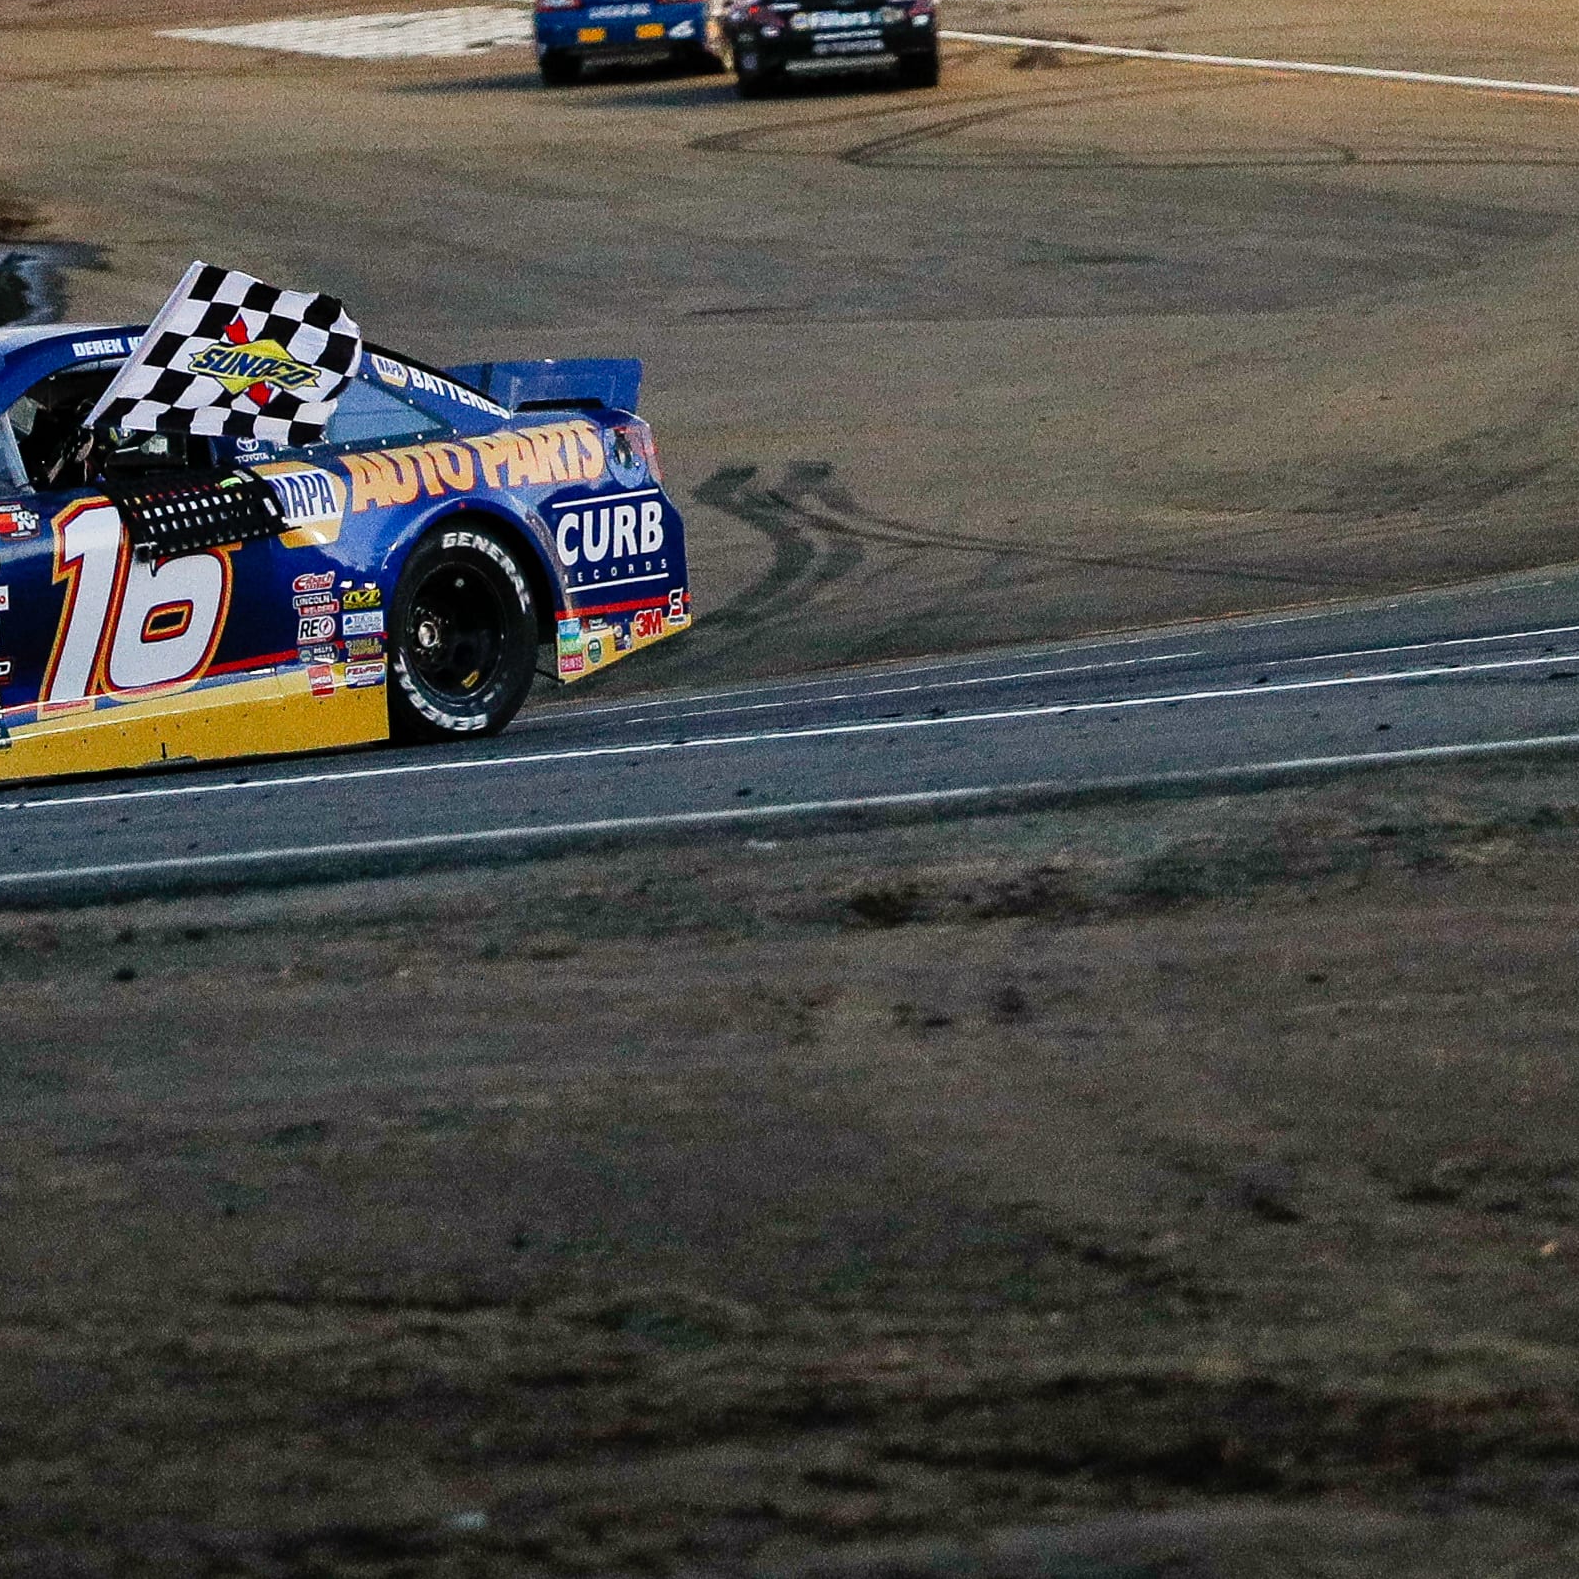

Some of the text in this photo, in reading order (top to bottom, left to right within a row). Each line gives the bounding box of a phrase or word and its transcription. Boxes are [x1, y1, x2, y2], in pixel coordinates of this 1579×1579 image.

[72, 338, 125, 357] DEREK
[197, 348, 313, 386] SUNOCO
[406, 366, 511, 420] BATTERIES
[235, 453, 270, 463] TOYOTA
[339, 419, 604, 513] AUTO PARTS
[556, 501, 665, 566] CURB
[40, 497, 237, 714] 16
[635, 609, 663, 637] 3M
